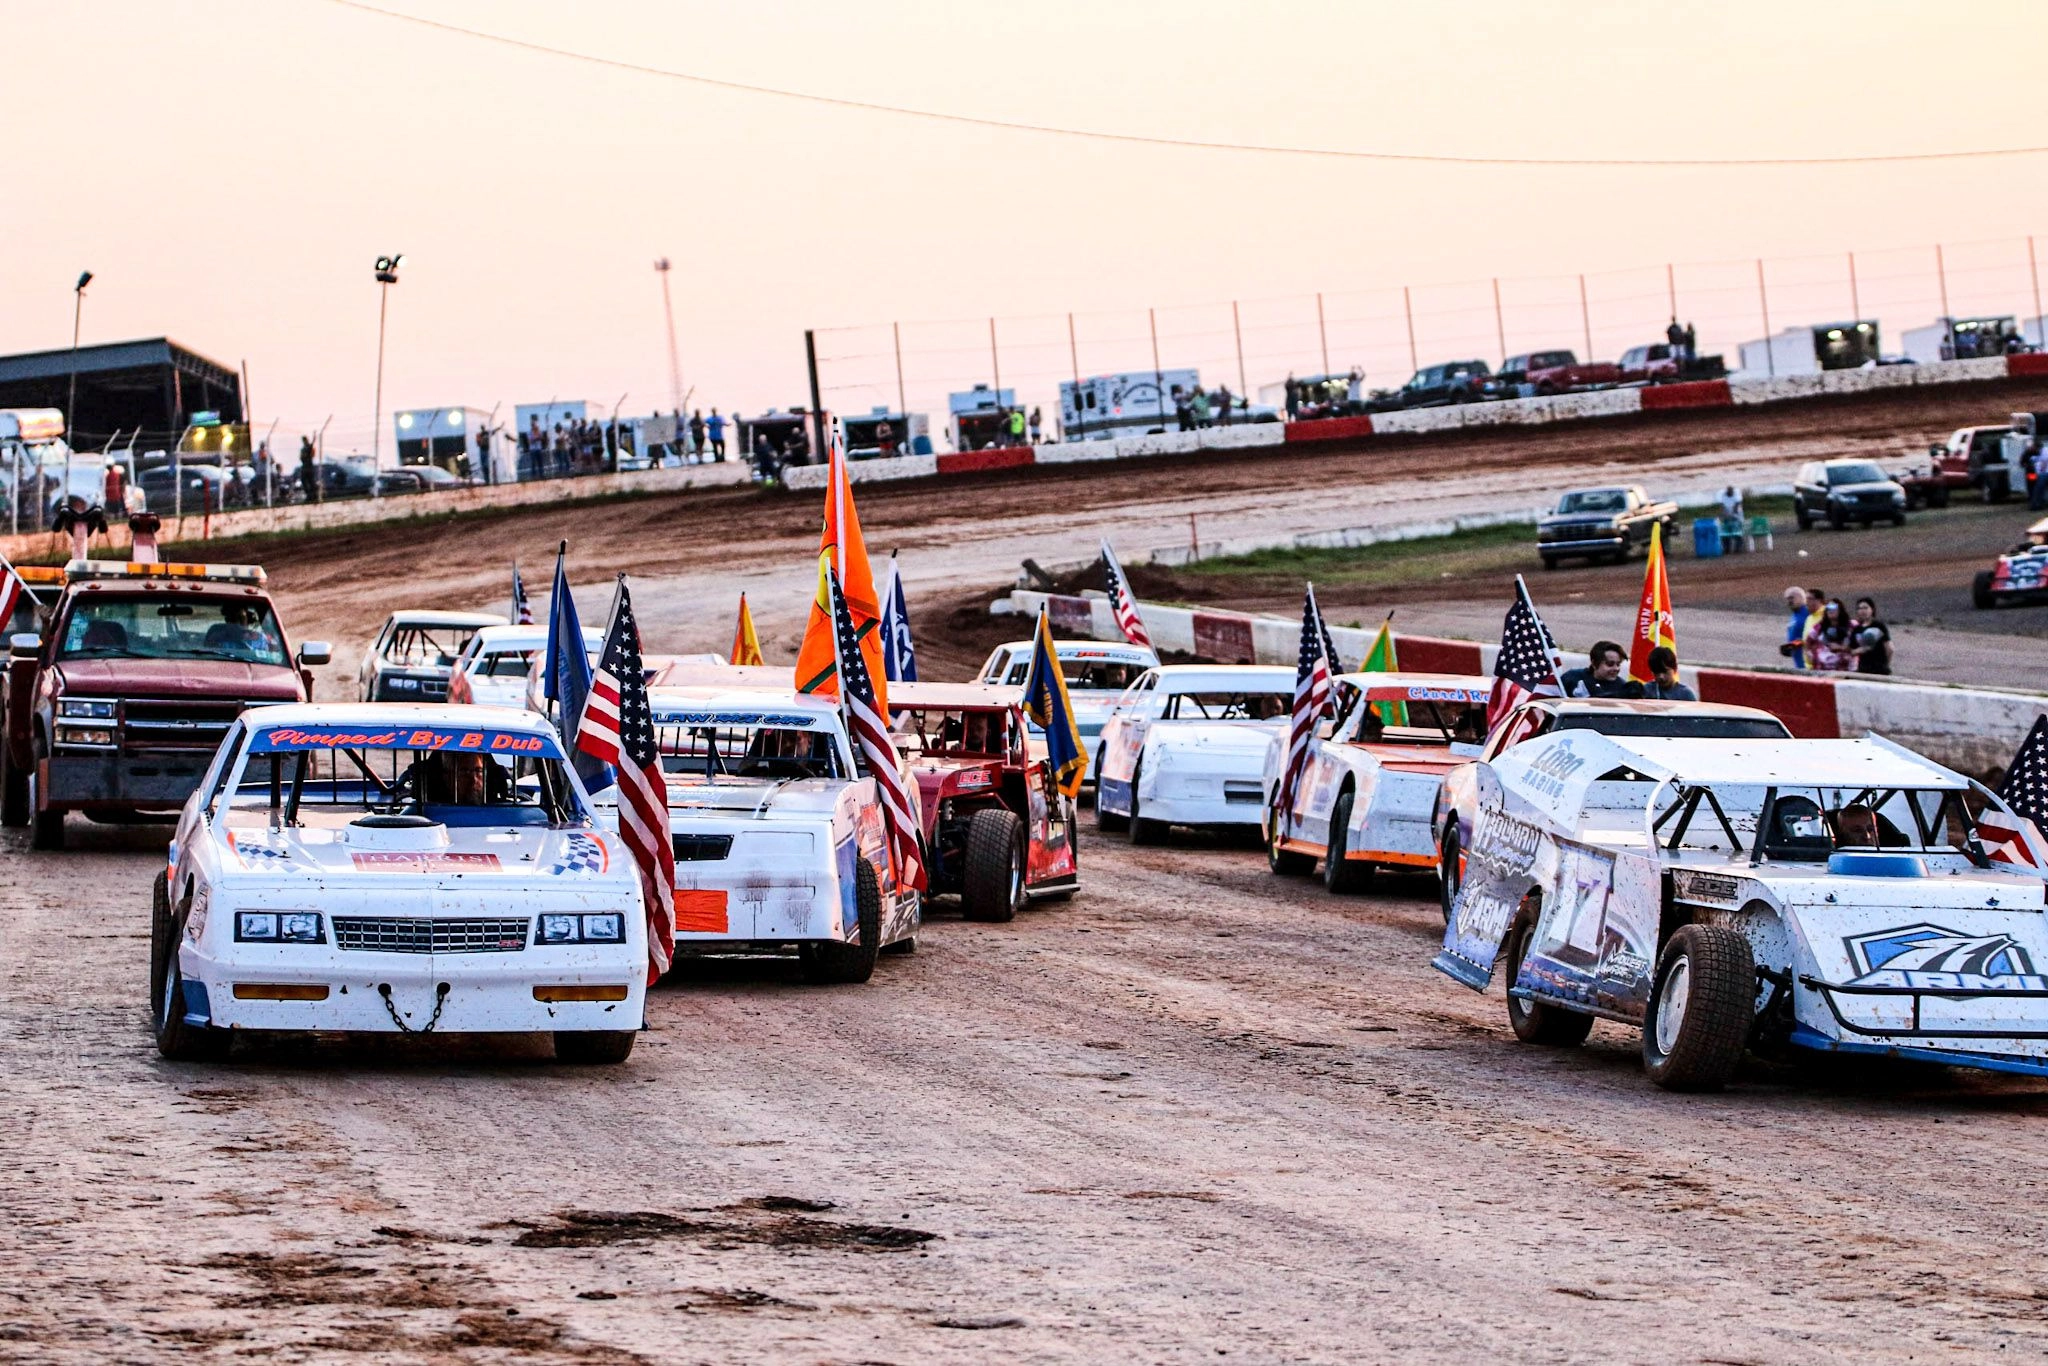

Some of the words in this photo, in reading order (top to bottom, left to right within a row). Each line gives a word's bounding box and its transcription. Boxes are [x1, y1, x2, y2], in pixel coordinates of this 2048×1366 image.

[1409, 687, 1466, 701] Church
[652, 712, 711, 724] LAW
[407, 730, 452, 750] By
[459, 732, 485, 748] B
[491, 734, 543, 751] Dub
[1521, 769, 1565, 798] RACING
